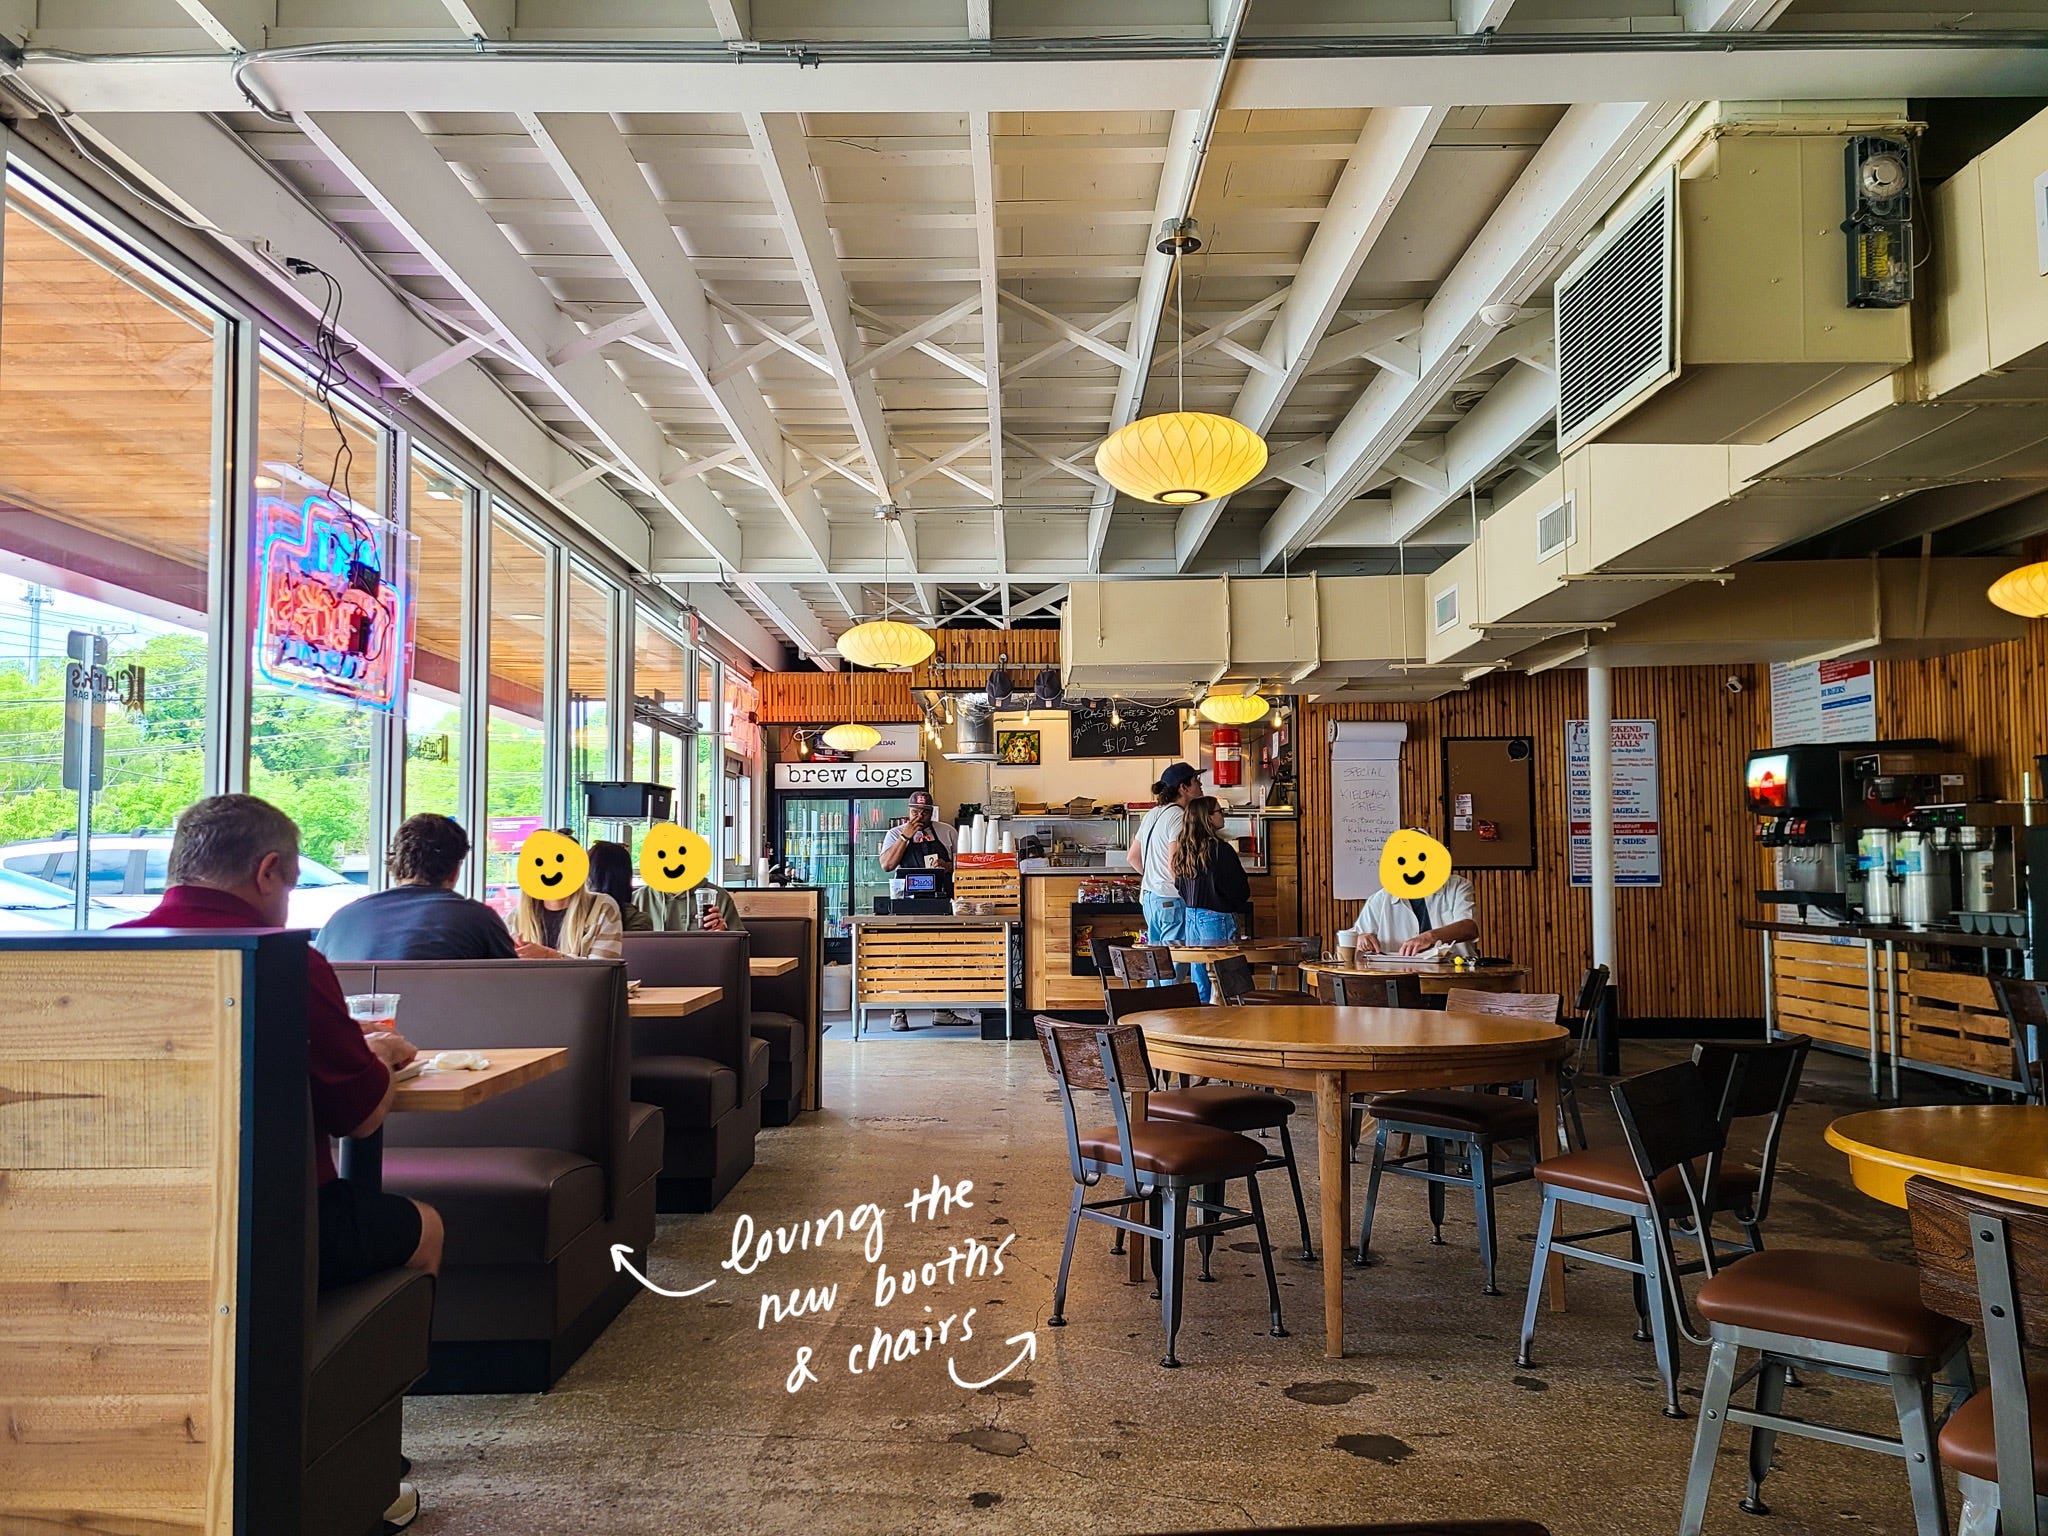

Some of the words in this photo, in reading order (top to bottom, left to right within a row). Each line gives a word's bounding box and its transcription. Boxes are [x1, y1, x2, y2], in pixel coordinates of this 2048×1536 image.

[1073, 709, 1115, 719] TOASTE
[1611, 725, 1642, 733] EKEND
[1611, 732, 1650, 740] EAKFAST
[1611, 740, 1641, 748] CIALS
[787, 765, 847, 783] brew
[856, 764, 913, 787] dogs
[1344, 767, 1386, 777] SPECIAL
[1340, 789, 1392, 800] KIELBASA
[1351, 801, 1385, 811] FRIES
